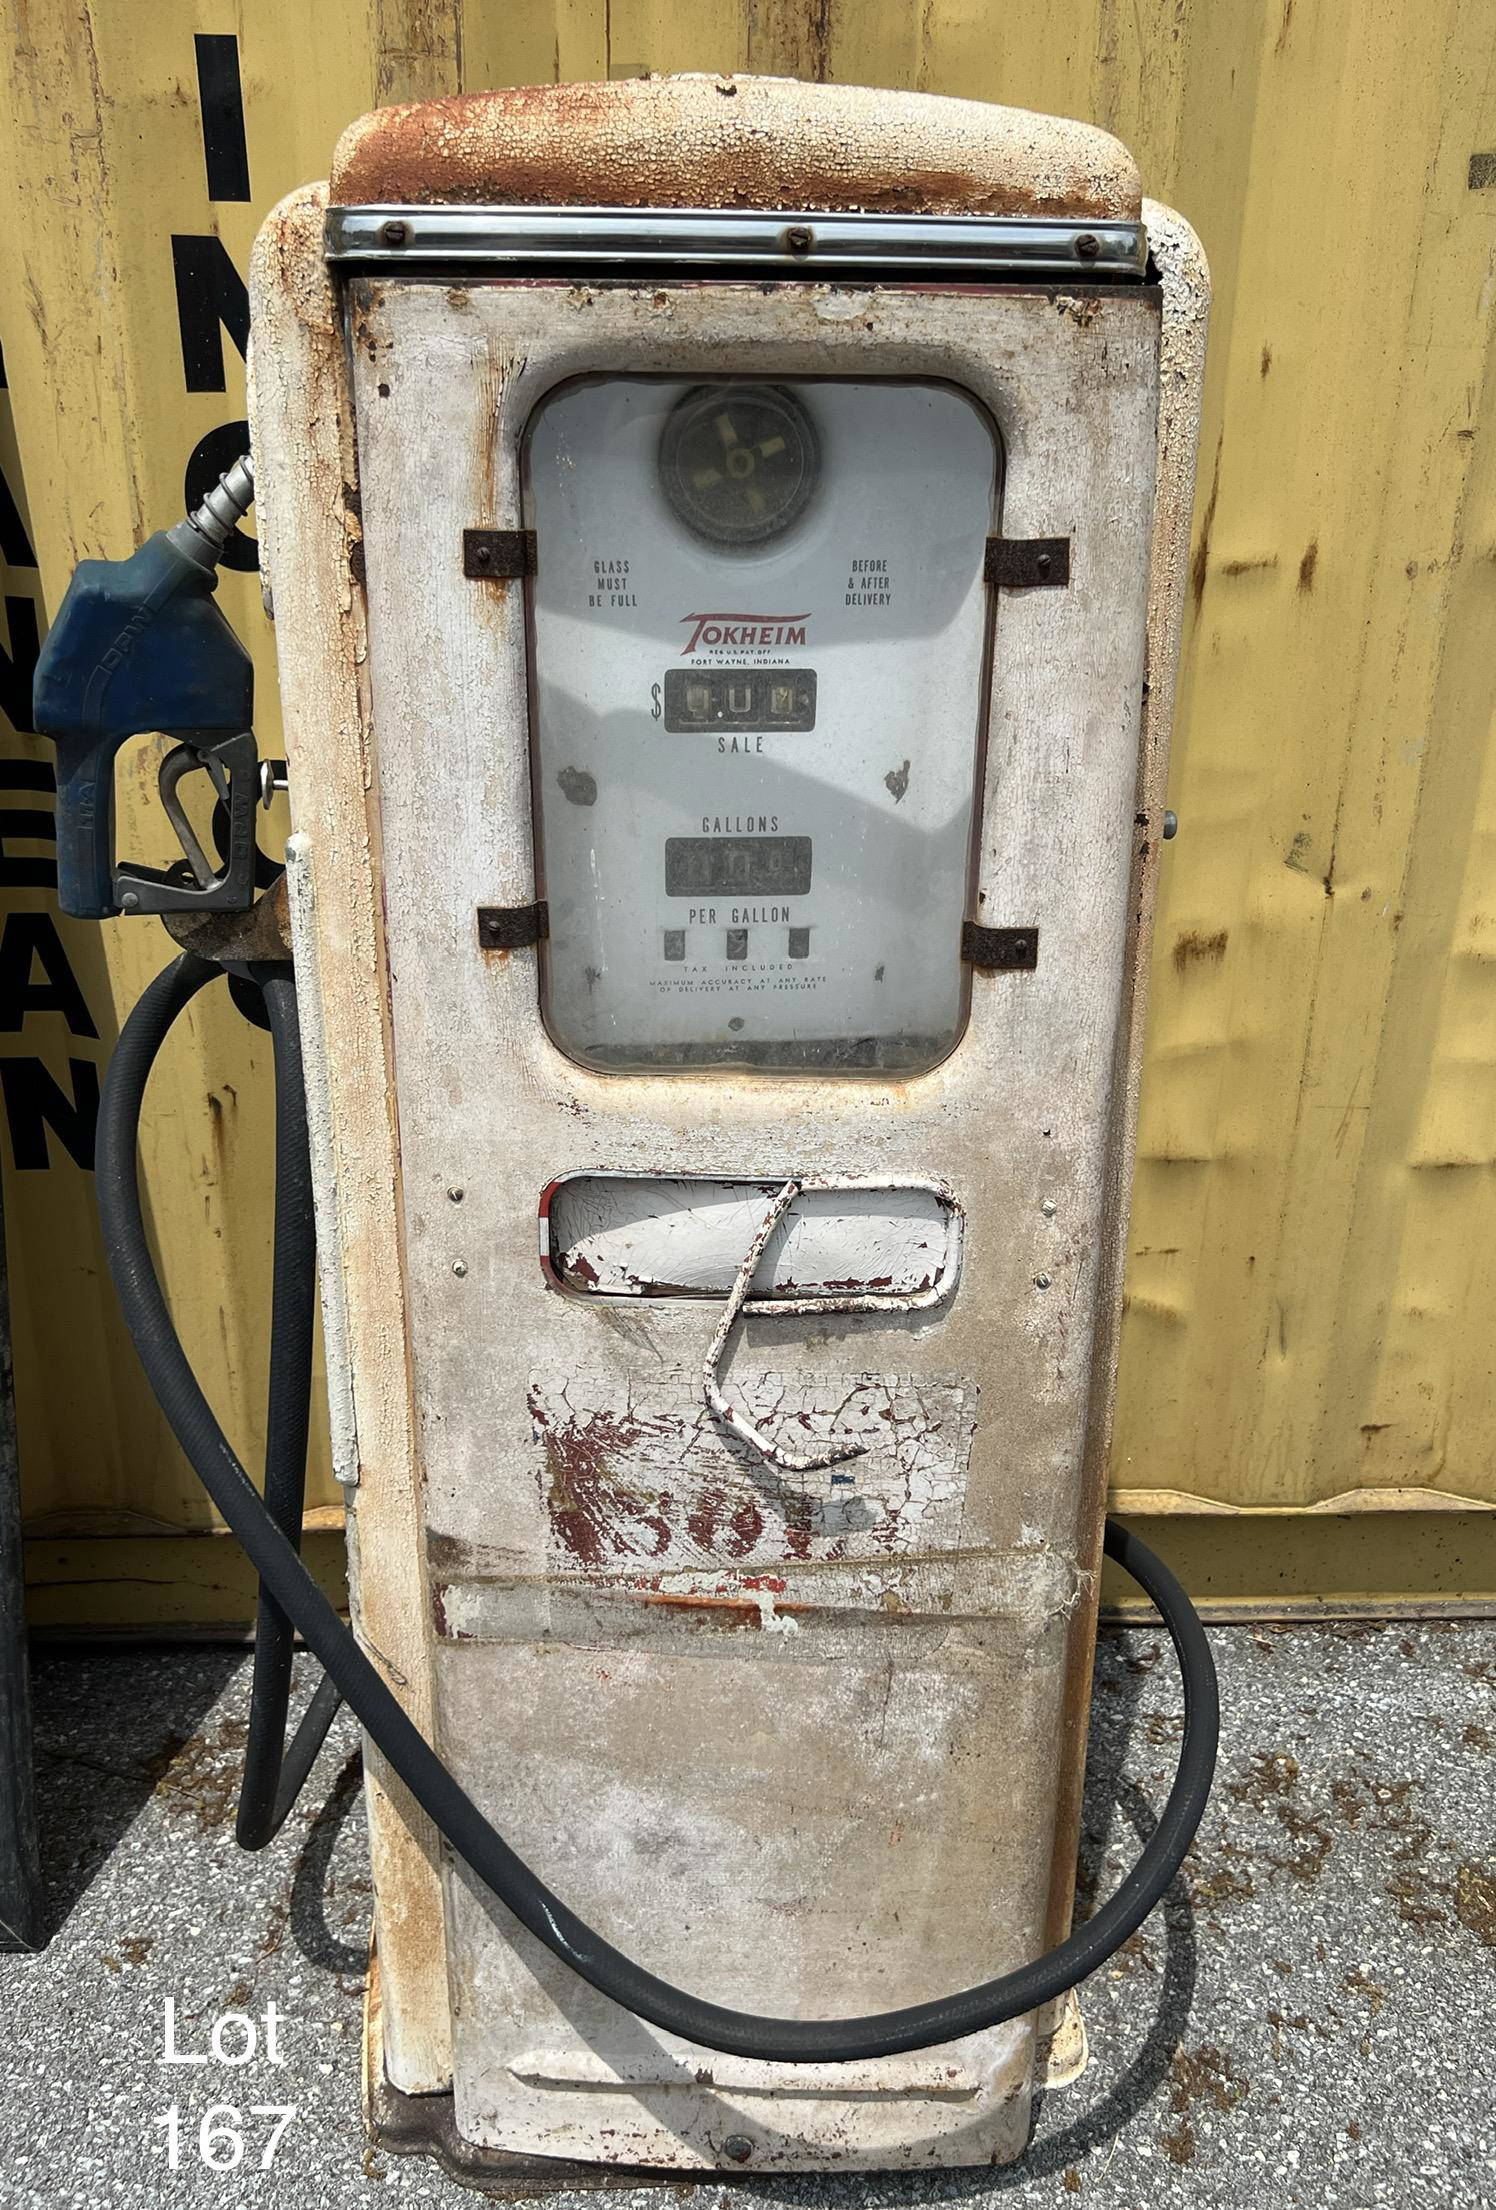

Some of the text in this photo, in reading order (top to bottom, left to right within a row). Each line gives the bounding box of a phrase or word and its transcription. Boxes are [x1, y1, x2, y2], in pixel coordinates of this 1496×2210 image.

[594, 560, 630, 574] GLASS
[852, 559, 888, 572] BEFORE
[597, 577, 627, 590] MUST
[847, 576, 890, 589] & AFTER
[588, 593, 638, 607] BE FULL
[845, 593, 892, 606] DELIVERY
[679, 612, 812, 656] TOKHEIM
[691, 658, 713, 666] FORT
[716, 658, 750, 666] WAYNE,
[717, 735, 764, 754] SALE
[702, 815, 780, 834] GALLONS
[689, 906, 791, 925] PER GALLON
[684, 962, 794, 973] TAX INCLUDED
[650, 979, 695, 987] MAXIMUM
[700, 978, 752, 986] ACCURACY
[778, 976, 798, 984] ANY
[804, 975, 829, 983] RATE
[678, 985, 722, 993] DELIVERY
[747, 983, 767, 991] ANY
[773, 982, 819, 991] PRESSURE
